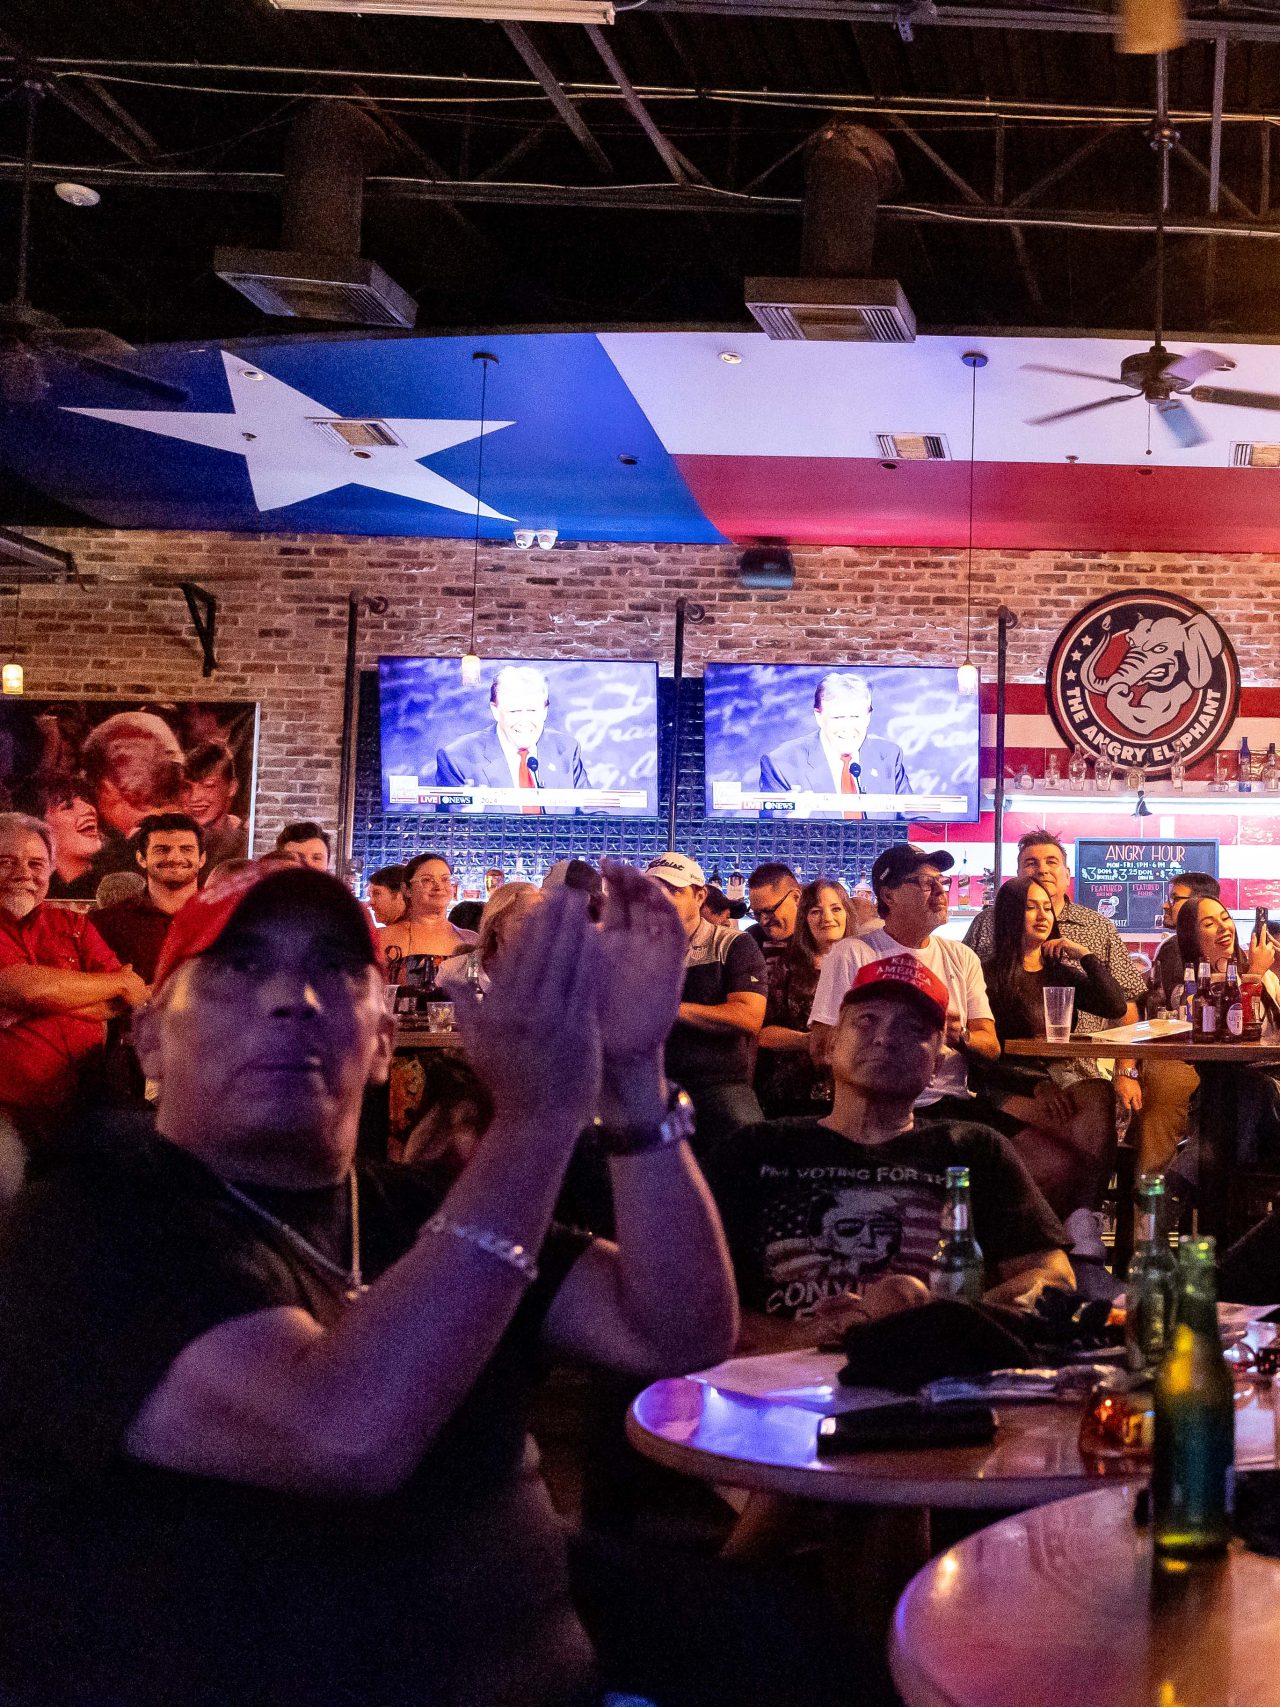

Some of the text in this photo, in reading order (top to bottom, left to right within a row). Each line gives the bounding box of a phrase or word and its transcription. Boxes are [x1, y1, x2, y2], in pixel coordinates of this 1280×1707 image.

[1066, 687, 1088, 723] THE
[1081, 725, 1147, 762] ANGRY
[419, 796, 471, 804] LIVE NEWS
[772, 802, 793, 810] NEWS
[1105, 845, 1186, 862] ANGRY HOUR
[1091, 884, 1123, 893] FEATURED
[891, 957, 924, 969] KEEP
[876, 965, 932, 986] AMERICA
[798, 1166, 870, 1180] VOTING
[875, 1166, 918, 1182] FOR
